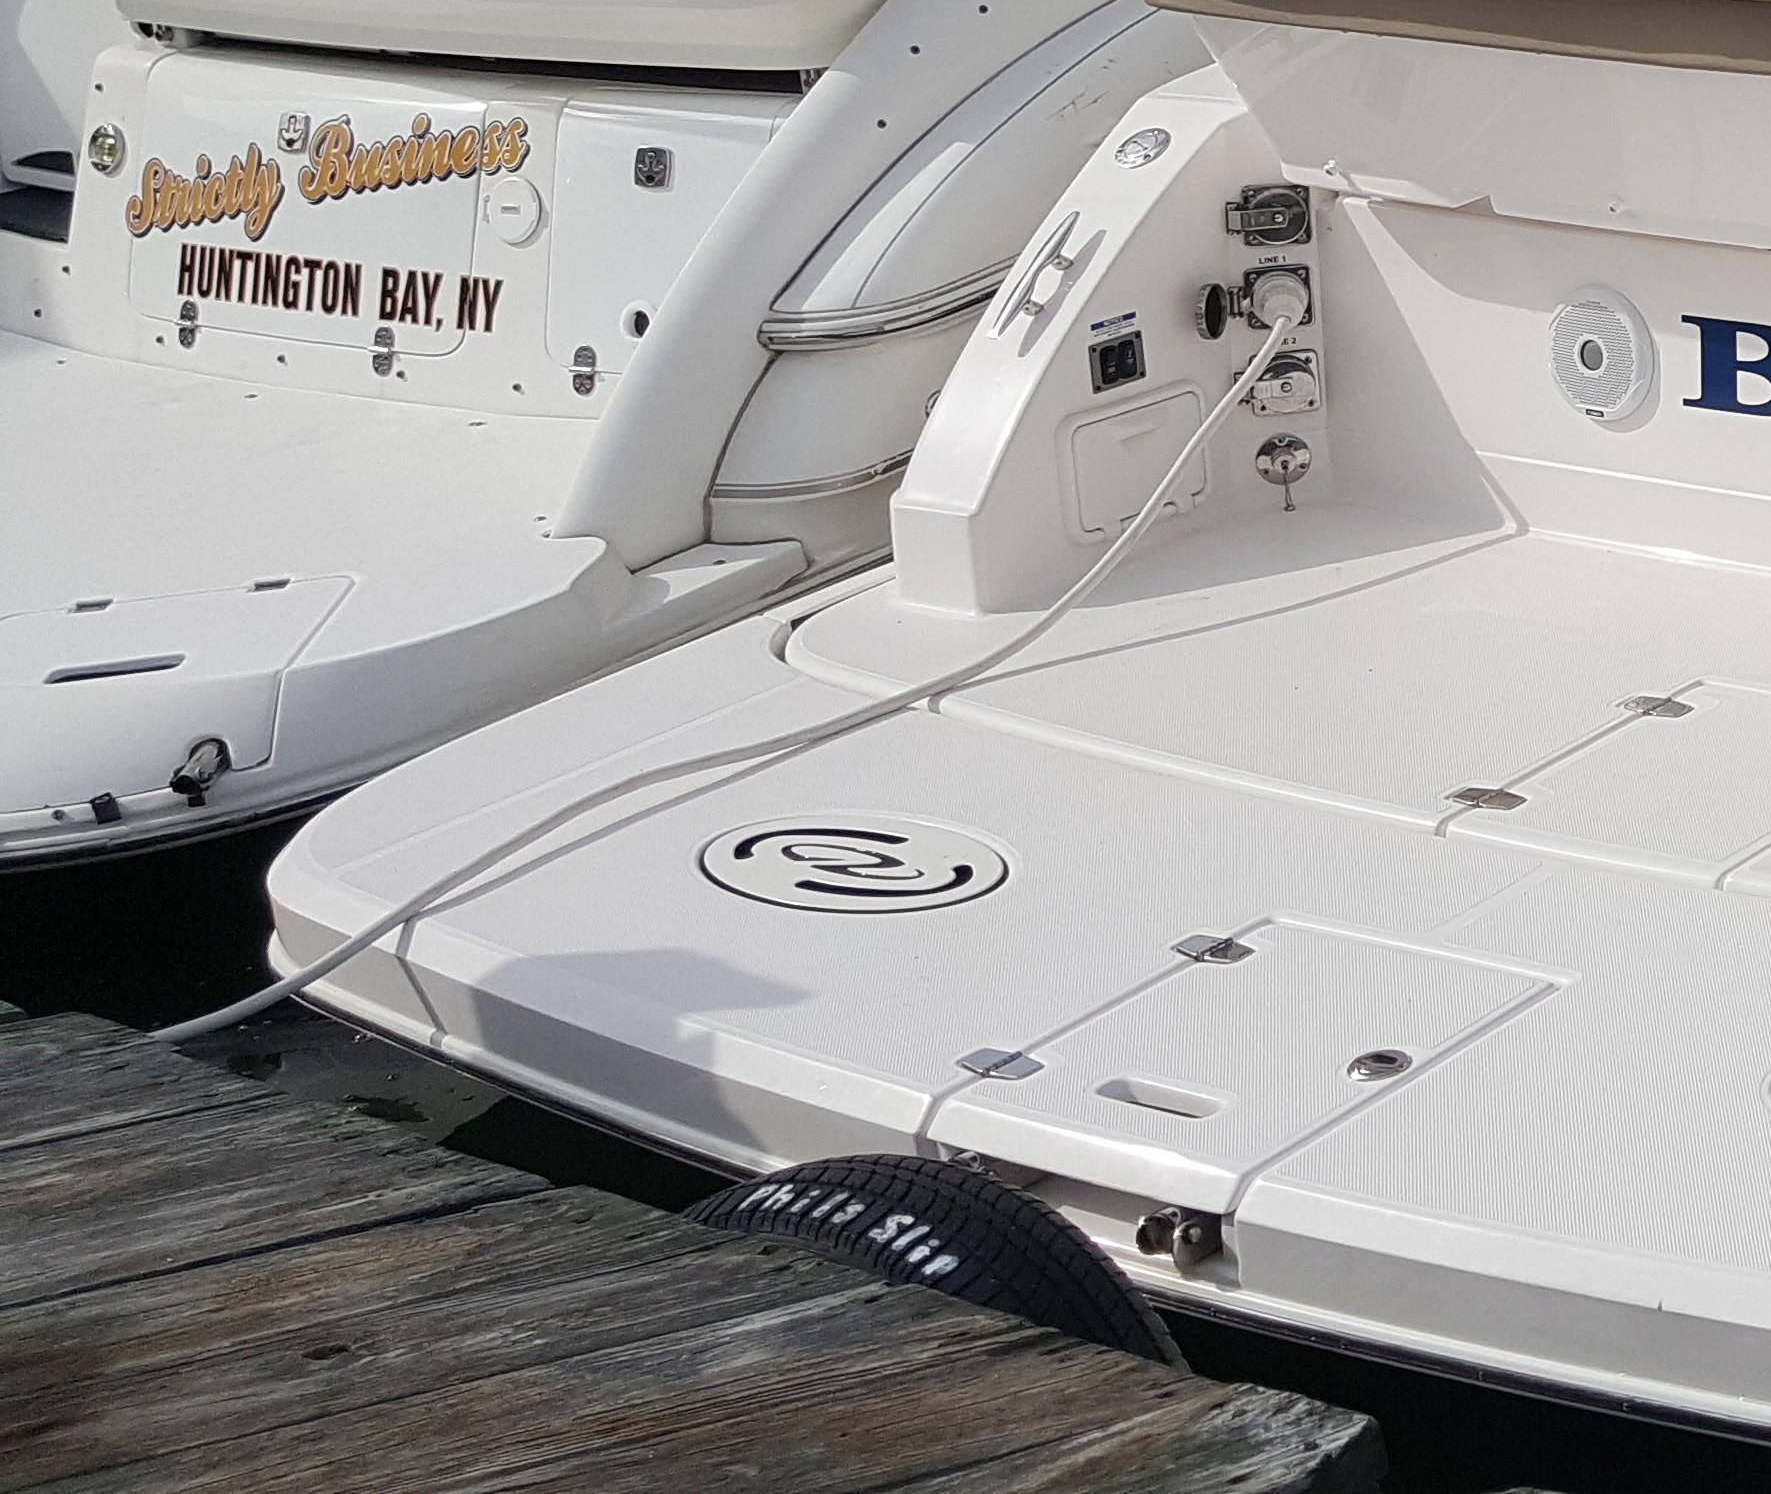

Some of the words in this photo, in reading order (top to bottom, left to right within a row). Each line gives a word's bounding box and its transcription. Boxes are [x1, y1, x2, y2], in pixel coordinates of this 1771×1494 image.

[126, 142, 286, 241] Strictly
[299, 112, 531, 205] Business
[177, 243, 363, 318] HUNTINGTON
[378, 266, 445, 331] BAY,
[455, 274, 505, 334] NY
[1258, 255, 1279, 264] LINE
[867, 1214, 960, 1276] Slip
